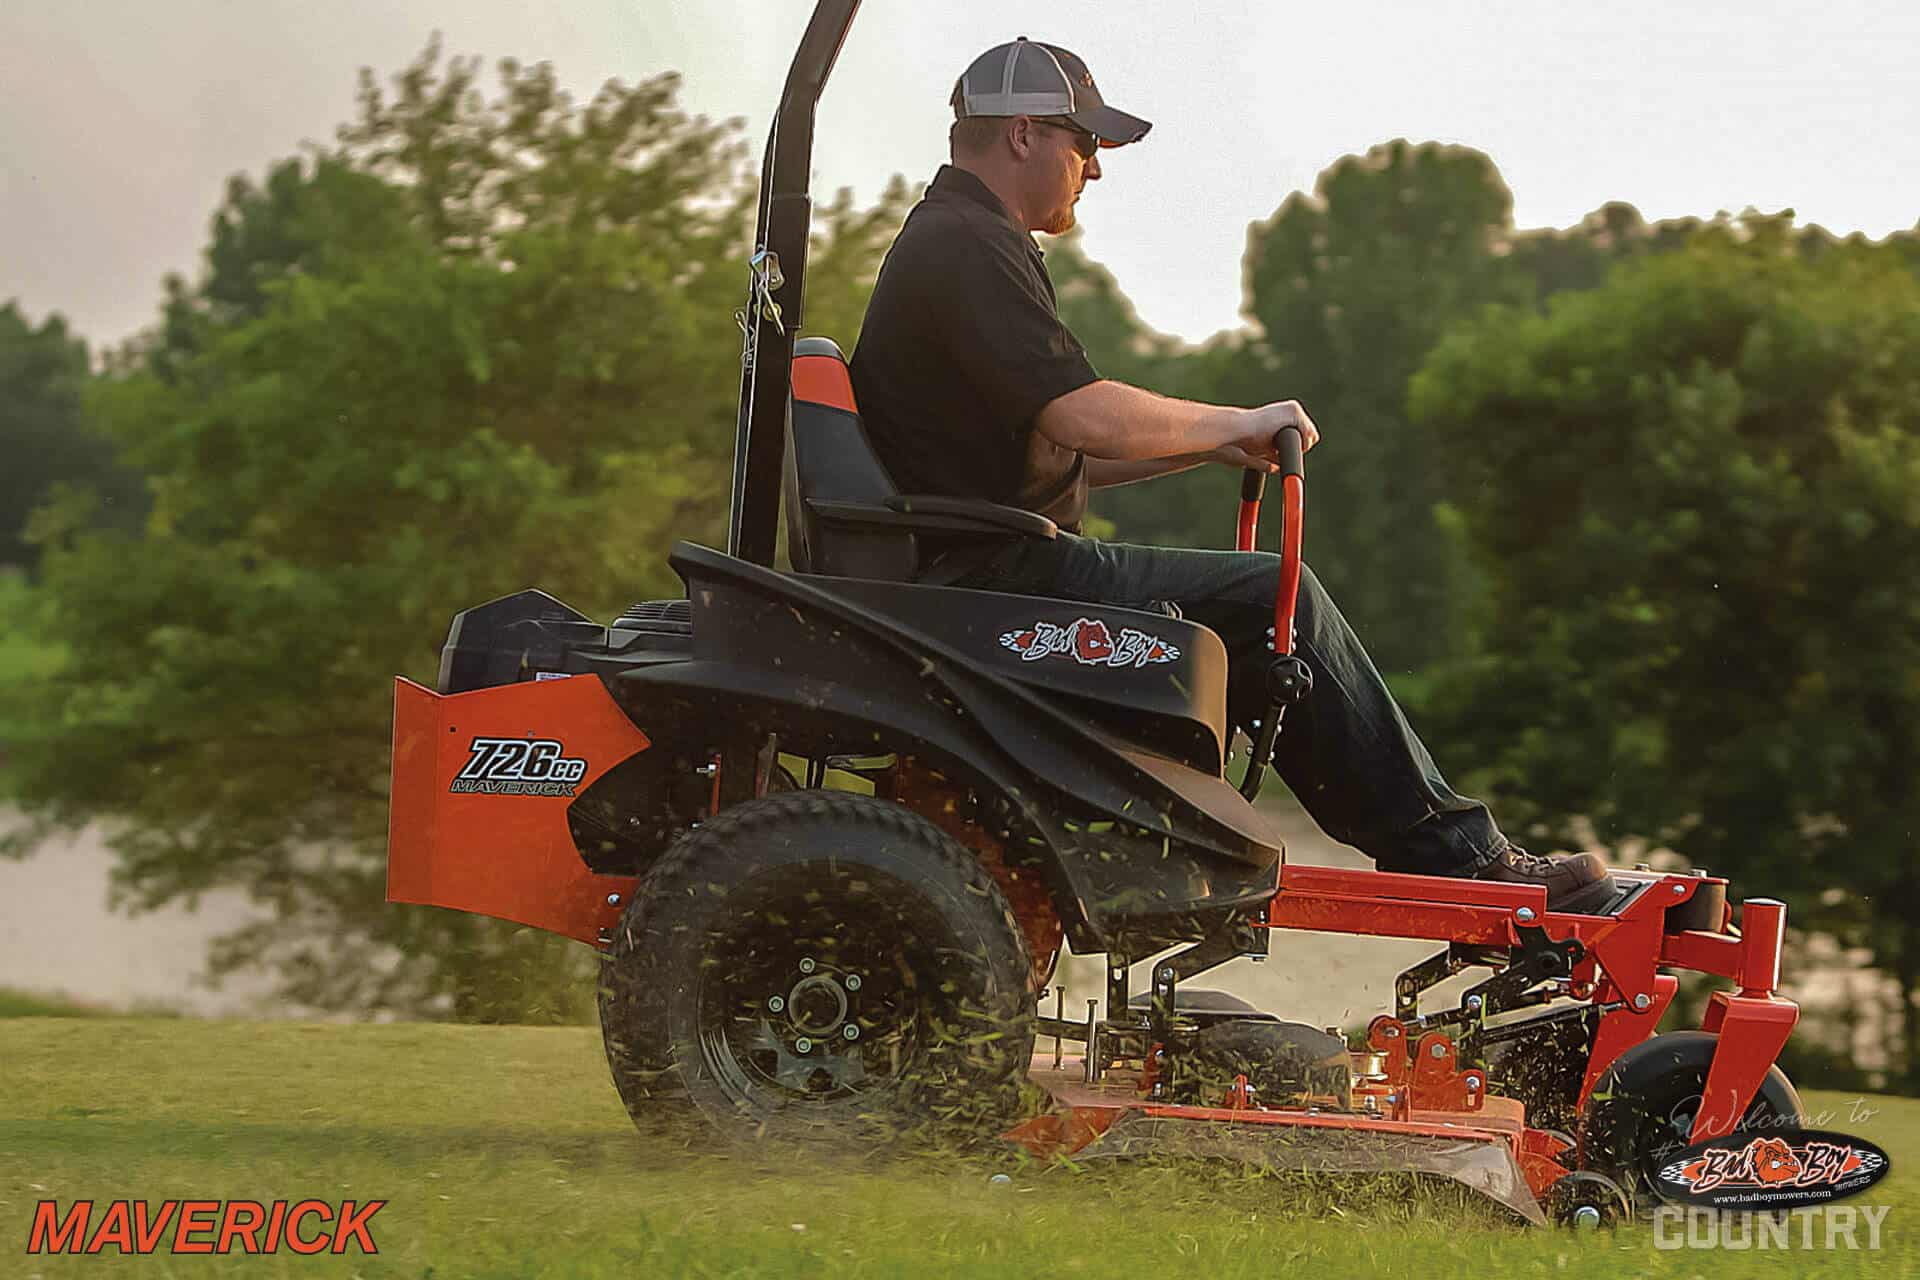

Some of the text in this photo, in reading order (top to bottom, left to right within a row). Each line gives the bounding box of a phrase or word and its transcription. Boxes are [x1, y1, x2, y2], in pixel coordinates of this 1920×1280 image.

[1022, 622, 1157, 668] Bad Boy
[458, 738, 587, 781] 726cc
[451, 780, 577, 797] MAVERICK
